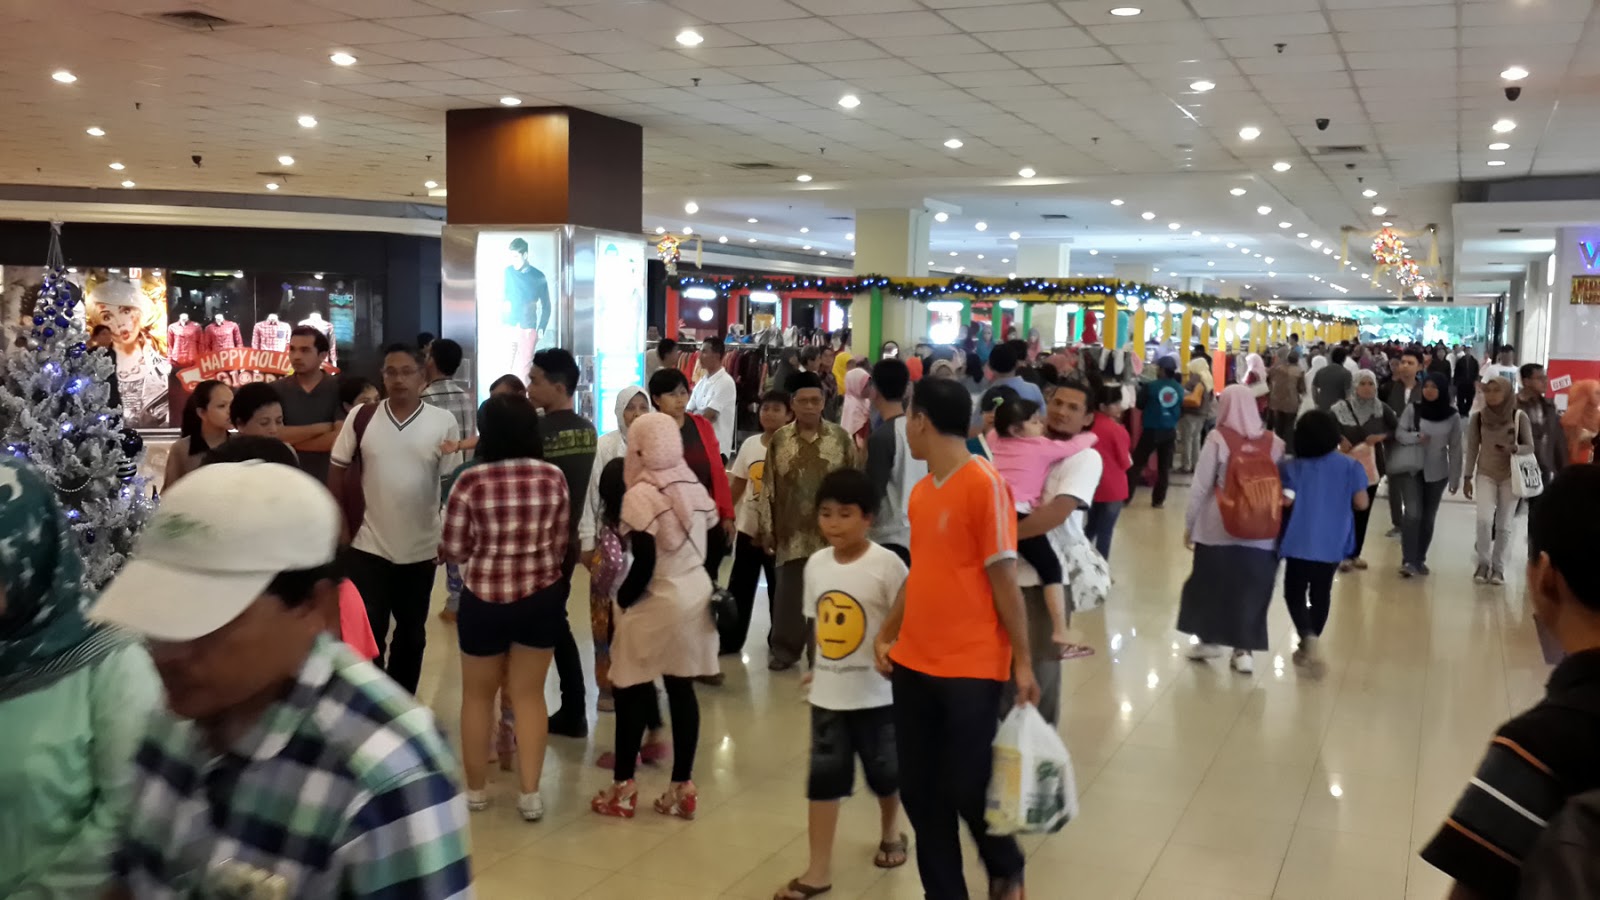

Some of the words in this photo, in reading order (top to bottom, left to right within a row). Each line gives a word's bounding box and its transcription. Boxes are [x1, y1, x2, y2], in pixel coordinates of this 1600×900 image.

[200, 349, 245, 372] HAPPY
[248, 351, 293, 372] HOLID
[216, 370, 283, 387] GIORD
